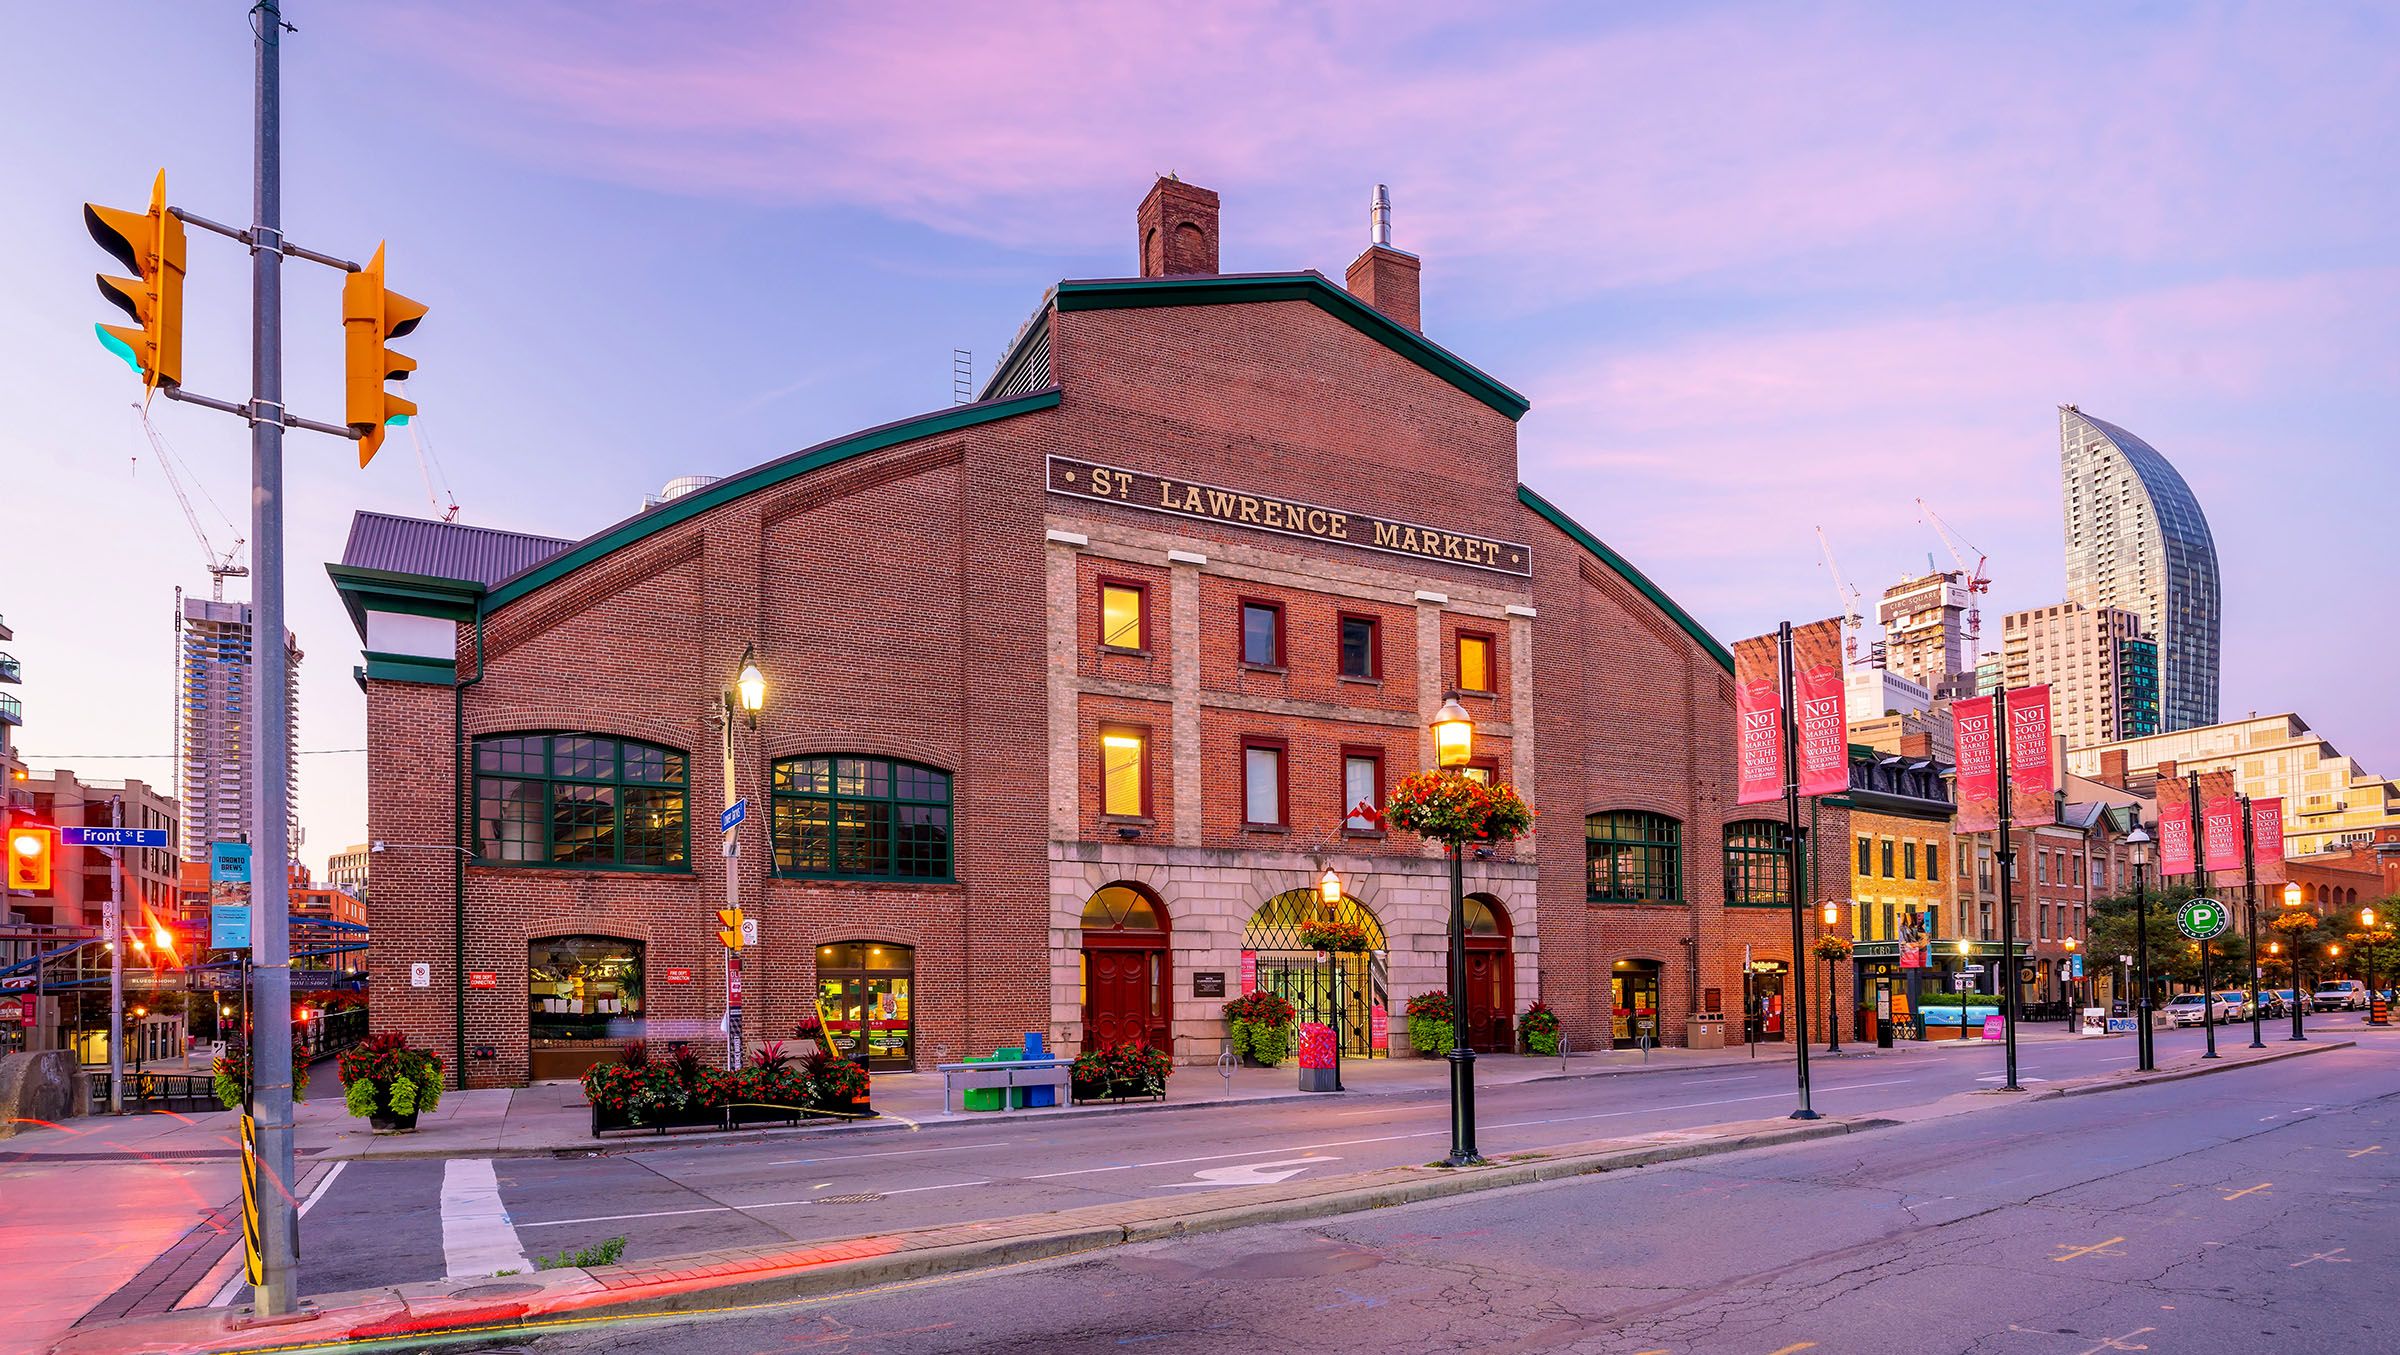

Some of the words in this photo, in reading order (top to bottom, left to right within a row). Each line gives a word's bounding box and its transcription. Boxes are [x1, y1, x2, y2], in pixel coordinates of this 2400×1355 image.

[1092, 468, 1133, 499] ST
[1160, 481, 1348, 539] LAWRENCE
[1373, 521, 1500, 565] MARKET
[1890, 600, 1906, 610] CIBC
[1909, 591, 1937, 605] SQUARE
[1806, 718, 1839, 731] FOOD
[2016, 724, 2046, 735] FOOD
[1745, 730, 1776, 742] FOOD
[1806, 728, 1839, 738] MARKET
[1961, 733, 1989, 744] FOOD
[2016, 732, 2045, 741] MARKET
[1745, 739, 1776, 749] MARKET
[1806, 740, 1817, 748] IN
[1820, 737, 1840, 747] THE
[1961, 741, 1989, 750] MARKET
[1746, 751, 1756, 759] IN
[1758, 748, 1776, 758] THE
[1806, 745, 1840, 756] WORLD
[2017, 747, 2046, 756] WORLD
[1746, 756, 1776, 766] WORLD
[1806, 755, 1840, 764] NATIONAL
[1962, 756, 1991, 765] WORLD
[1745, 766, 1776, 774] NATIONAL
[83, 830, 121, 842] Front
[137, 831, 145, 842] E
[218, 856, 245, 864] TORONTO
[2180, 900, 2223, 918] MUNICIPAL
[2193, 909, 2211, 925] P
[2181, 921, 2223, 938] PARKING
[1869, 946, 1890, 955] LCBO
